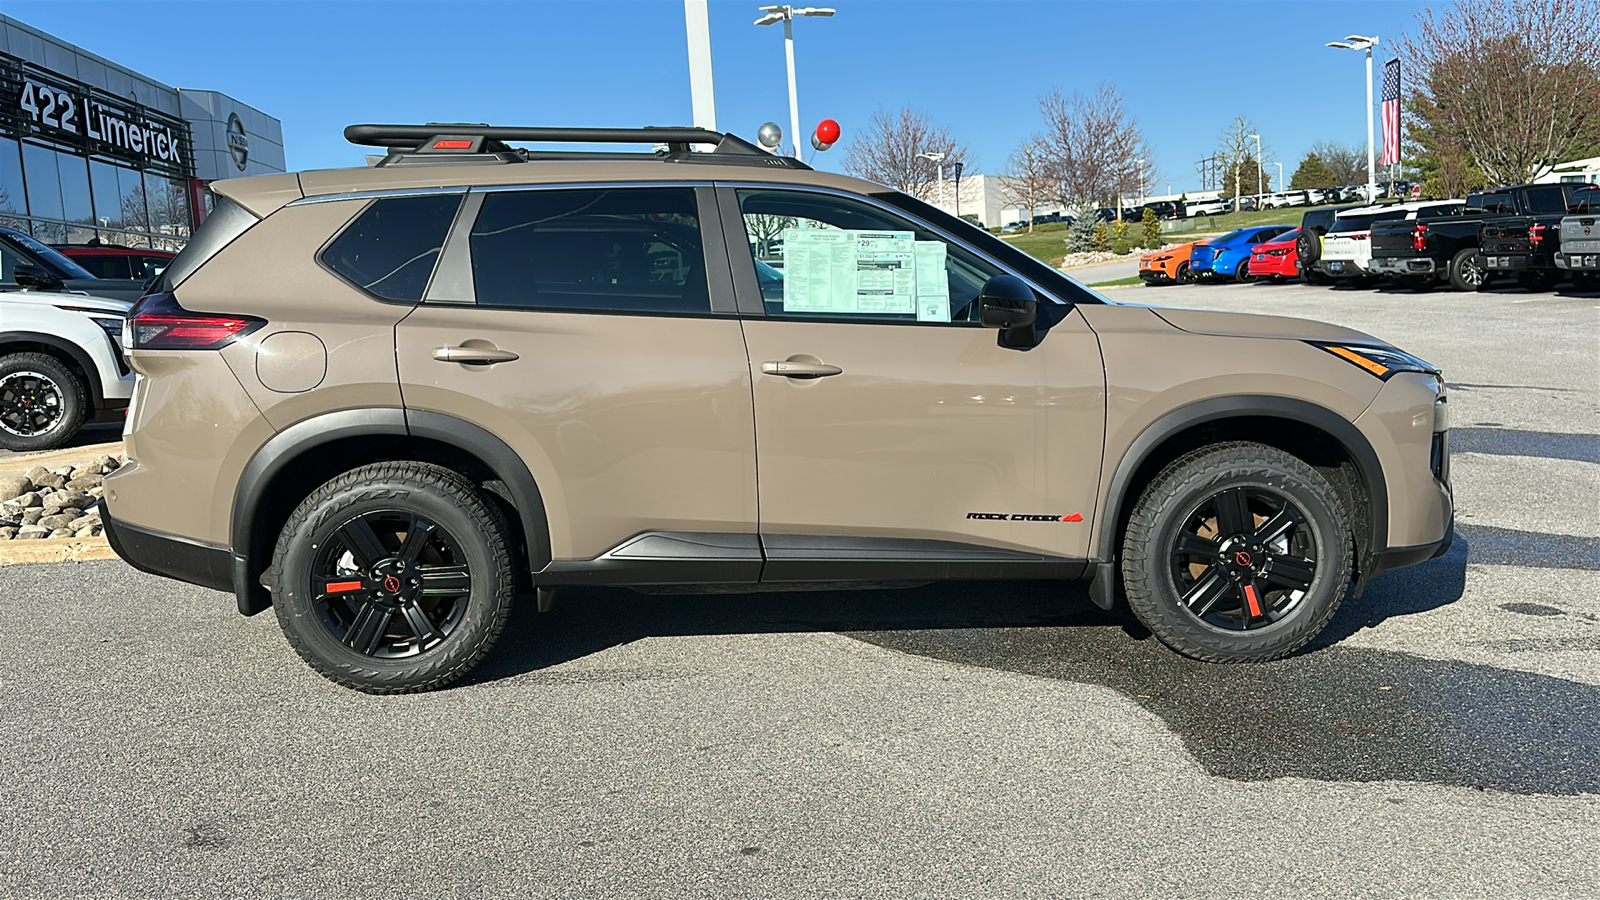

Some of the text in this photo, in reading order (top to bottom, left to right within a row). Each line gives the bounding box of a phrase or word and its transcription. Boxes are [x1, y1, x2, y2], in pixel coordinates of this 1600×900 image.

[21, 82, 180, 163] 422 Limerick
[966, 512, 1062, 522] ROCK CREEK
